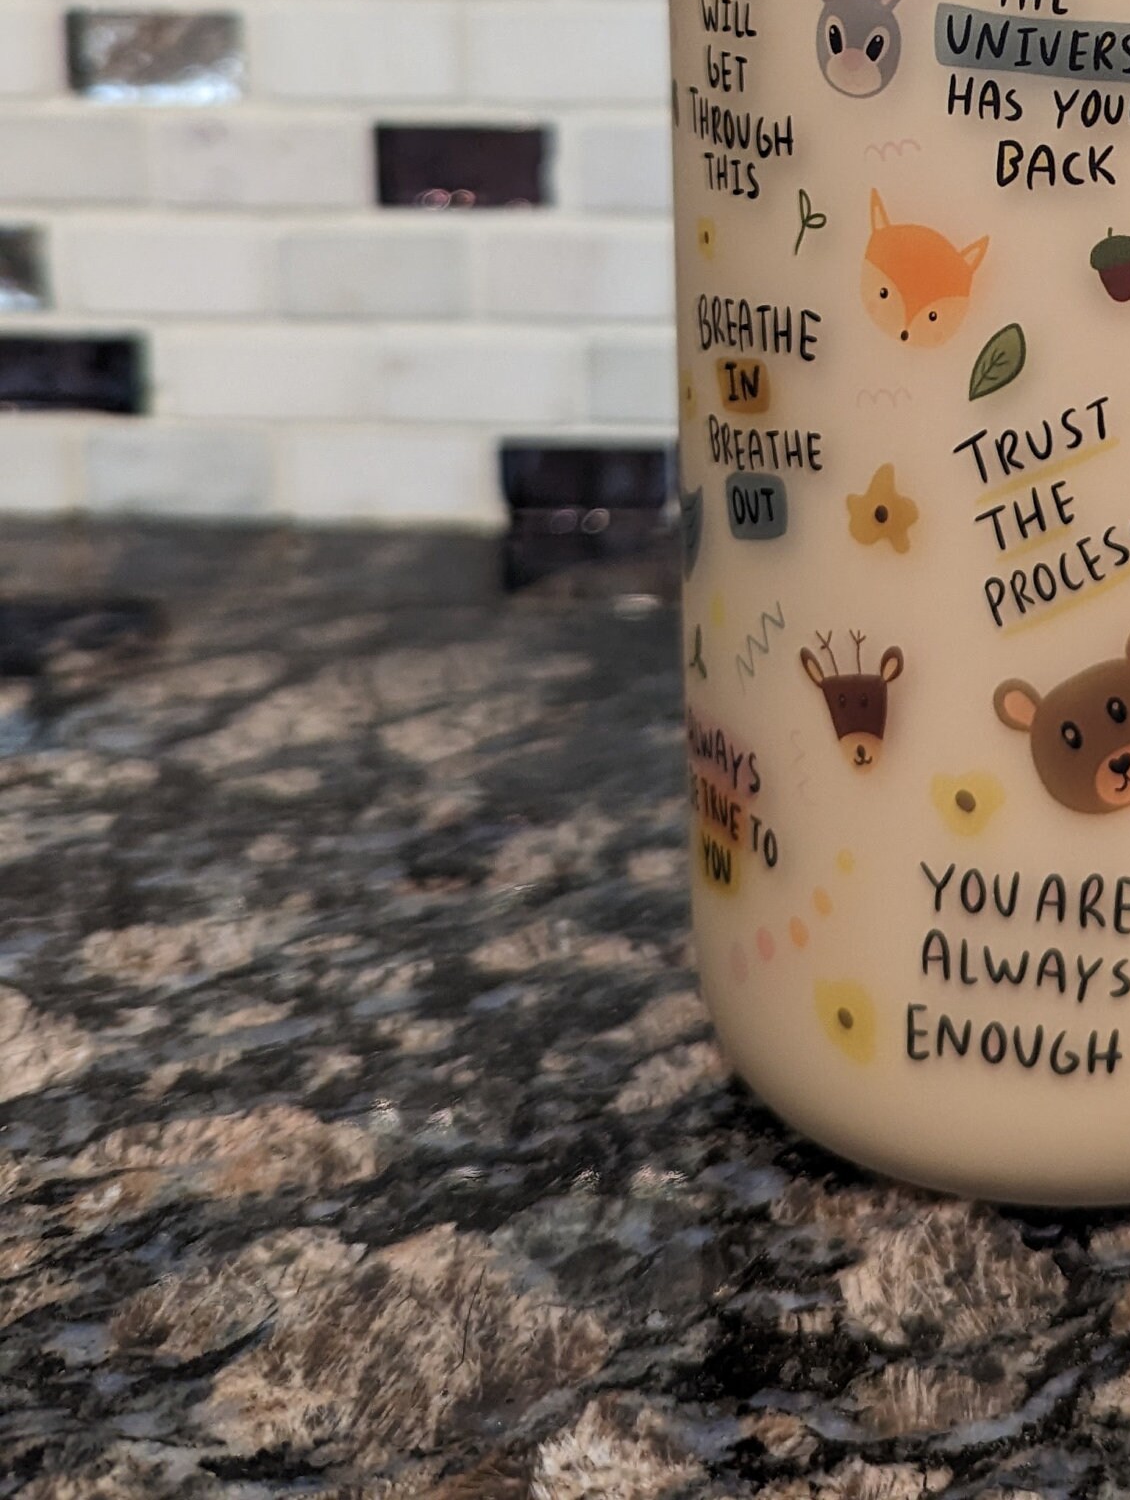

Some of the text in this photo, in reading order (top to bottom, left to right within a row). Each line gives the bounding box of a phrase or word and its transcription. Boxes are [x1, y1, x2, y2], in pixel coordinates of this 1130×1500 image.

[707, 44, 748, 92] GET
[689, 86, 794, 158] THROUGH
[948, 73, 1023, 122] HAS
[704, 152, 760, 199] THIS
[996, 139, 1116, 190] BACK
[699, 293, 822, 362] BREATHE
[725, 361, 760, 401] IN
[708, 414, 823, 471] BREATHE
[953, 396, 1109, 484] TRUST
[731, 485, 775, 525] OUT
[974, 480, 1075, 551] THE
[701, 777, 742, 841] TRUE
[750, 814, 778, 867] TO
[702, 832, 732, 884] YOU
[920, 861, 1020, 917] YOU
[906, 1002, 1123, 1075] ENOUGH
